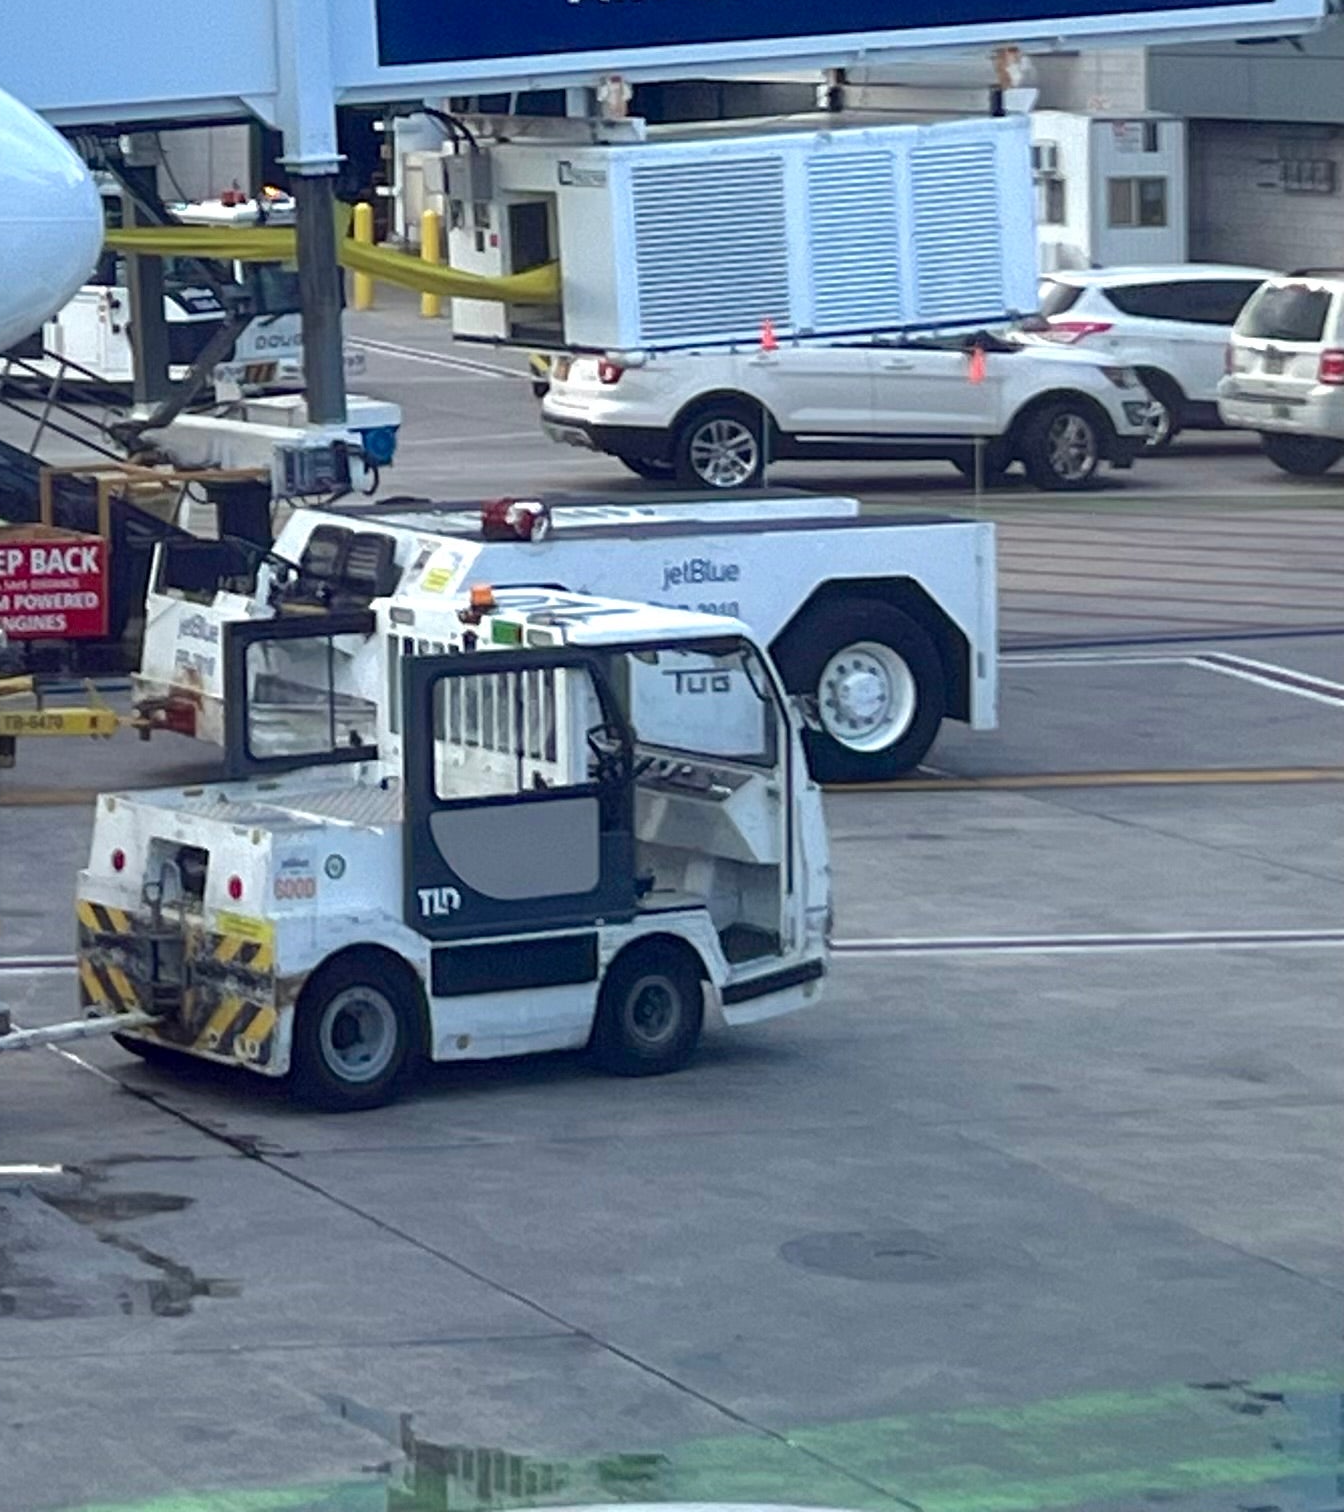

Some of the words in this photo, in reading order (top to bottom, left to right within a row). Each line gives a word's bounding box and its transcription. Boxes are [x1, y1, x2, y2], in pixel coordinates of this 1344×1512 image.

[30, 546, 100, 575] BACK
[661, 558, 740, 591] jetBlue
[13, 591, 99, 611] POWERED
[662, 668, 732, 695] TUG
[418, 886, 462, 917] TLD
